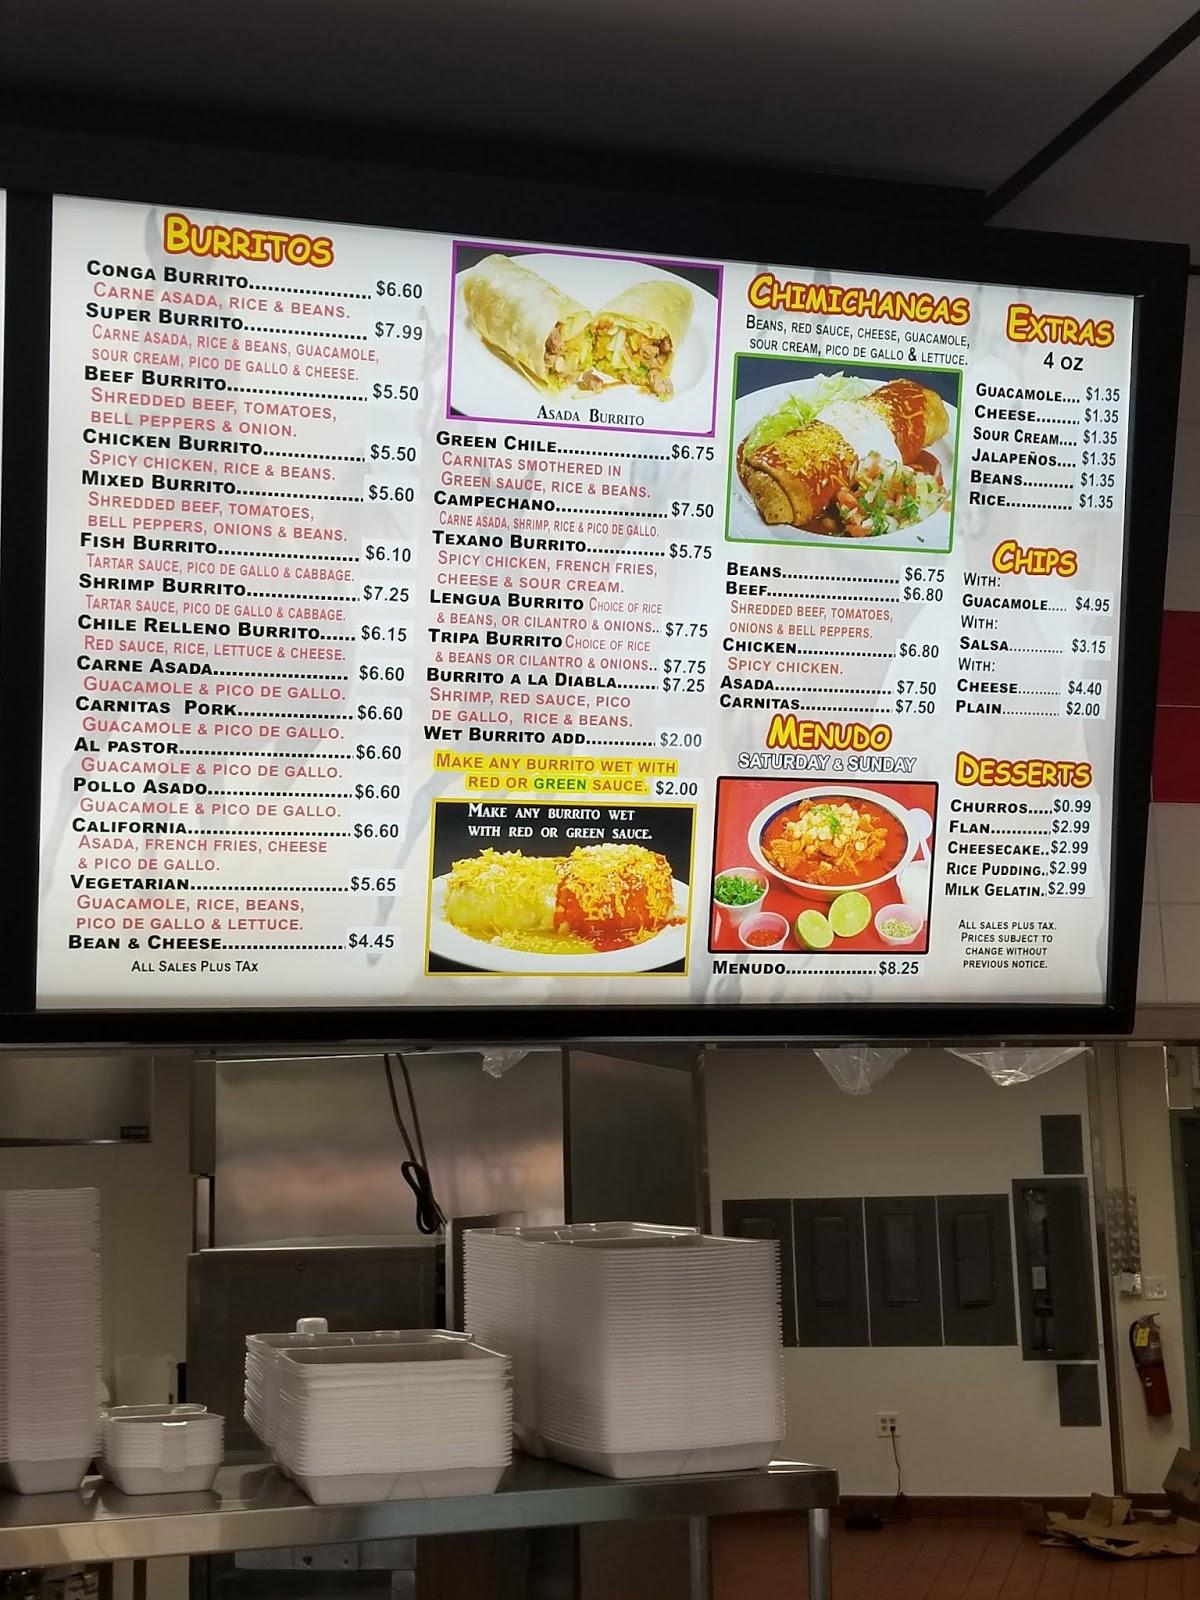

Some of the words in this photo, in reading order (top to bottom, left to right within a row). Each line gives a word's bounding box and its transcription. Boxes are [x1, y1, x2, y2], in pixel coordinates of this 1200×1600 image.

[164, 213, 334, 267] BURRITOS
[87, 260, 157, 282] CONGA
[376, 280, 422, 299] $6.60
[748, 272, 970, 325] CHIMICHANGAS
[86, 302, 151, 323] SUPER
[375, 321, 422, 341] $7.99
[1007, 304, 1115, 347] EXTRAS
[746, 314, 786, 334] BEANS,
[791, 322, 812, 336] RED
[814, 321, 853, 340] SAUCE,
[858, 328, 900, 344] CHEESE,
[905, 332, 969, 349] GUACAMOLE,
[750, 338, 778, 350] SOUR
[782, 339, 822, 354] CREAM,
[826, 344, 849, 358] PICO
[853, 347, 867, 357] DE
[871, 348, 903, 360] GALLO
[908, 347, 917, 361] &
[922, 352, 968, 365] LETTUCE.
[1043, 351, 1054, 369] 4
[1061, 356, 1084, 371] OZ
[85, 365, 134, 383] BEEF
[372, 383, 418, 401] $5.50
[1086, 386, 1120, 402] $1.35
[91, 387, 185, 408] SHREDDED
[193, 398, 237, 415] BEEF,
[244, 402, 336, 422] TOMATOES,
[536, 405, 580, 421] ASADA
[589, 408, 644, 426] BURRITO
[1085, 408, 1118, 424] $1.35
[973, 426, 1009, 442] SOUR
[1083, 429, 1117, 446] $1.35
[83, 428, 170, 449] CHICKEN
[368, 444, 416, 464] $5.50
[436, 431, 496, 449] GREEN
[671, 444, 714, 461] $6.75
[442, 451, 512, 469] CARNITAS
[518, 459, 603, 475] SMOTHERED
[608, 465, 621, 476] IN
[1082, 448, 1116, 468] $1.35
[82, 470, 144, 488] MIXED
[369, 484, 414, 502] $5.60
[1078, 470, 1115, 488] $1.35
[1079, 490, 1113, 509] $1.35
[672, 501, 714, 518] $7.50
[80, 532, 125, 549] FISH
[365, 545, 411, 562] $6.10
[432, 530, 503, 549] TEXANO
[669, 543, 712, 559] $5.75
[992, 540, 1078, 576] CHIPS
[905, 567, 944, 582] $6.75
[964, 572, 1000, 589] WITH:
[79, 573, 154, 591] SHRIMP
[363, 585, 409, 602] $7.25
[901, 586, 943, 603] $6.80
[430, 587, 501, 607] LENGUA
[508, 593, 584, 610] BURRITO
[589, 597, 624, 612] CHOICE
[628, 603, 639, 613] OF
[643, 604, 662, 614] RICE
[1075, 596, 1110, 612] $4.95
[731, 600, 793, 616] SHREDDED
[797, 606, 826, 620] BEEF,
[831, 607, 892, 623] TOMATOES,
[78, 614, 136, 631] CHILE
[144, 617, 231, 636] RELLENO
[361, 625, 407, 642] $6.15
[665, 622, 707, 638] $7.75
[730, 622, 773, 634] ONIONS
[777, 624, 784, 636] &
[788, 624, 816, 636] BELL
[820, 626, 872, 638] PEPPERS.
[961, 615, 998, 630] WITH:
[428, 628, 479, 644] TRIPA
[486, 628, 564, 648] BURRITO
[563, 634, 605, 650] CHOICE
[610, 640, 623, 651] OF
[628, 641, 650, 651] RICE
[1072, 638, 1106, 654] $3.15
[899, 642, 939, 658] $6.80
[77, 655, 143, 672] CARNE
[359, 665, 404, 681] $6.60
[664, 658, 706, 674] $7.75
[728, 656, 772, 675] SPICY
[776, 661, 843, 674] CHICKEN.
[958, 657, 995, 672] WITH:
[663, 677, 705, 693] $7.25
[897, 680, 936, 695] $7.50
[1068, 680, 1102, 696] $4.40
[76, 696, 170, 714] CARNITAS
[357, 704, 403, 722] $6.60
[895, 699, 935, 714] $7.50
[1066, 700, 1100, 716] $2.00
[424, 726, 463, 741] WET
[467, 727, 545, 743] BURRITO
[660, 732, 702, 747] $2.00
[767, 713, 892, 752] MENUDO
[356, 744, 401, 761] $6.60
[436, 754, 482, 768] MAKE
[488, 758, 520, 770] ANY
[526, 759, 594, 771] BURRITO
[600, 762, 632, 772] WET
[638, 762, 675, 774] WITH
[738, 753, 830, 771] SATURDAY
[834, 758, 844, 771] &
[848, 756, 916, 773] SUNDAY
[955, 751, 1092, 788] DESSERTS
[74, 777, 135, 793] POLLO
[355, 784, 400, 800] $6.60
[468, 776, 500, 788] RED
[506, 778, 527, 788] OR
[534, 778, 586, 790] GREEN
[592, 780, 648, 792] SAUCE.
[656, 780, 697, 796] $2.00
[468, 804, 507, 818] MAKE
[515, 808, 540, 818] ANY
[548, 809, 600, 820] BURRITO
[609, 810, 634, 820] WET
[1053, 799, 1091, 814] $0.99
[354, 823, 399, 839] $6.60
[468, 826, 500, 836] WITH
[508, 826, 533, 837] RED
[541, 828, 558, 838] OR
[566, 828, 604, 838] GREEN
[612, 829, 652, 840] SAUCE.
[1050, 819, 1090, 834] $2.99
[1051, 840, 1088, 855] $2.99
[946, 862, 979, 878] RICE
[1049, 860, 1087, 875] $2.99
[350, 876, 396, 892] $5.65
[945, 881, 981, 896] MILK
[1048, 881, 1085, 898] $2.99
[958, 919, 977, 933] ALL
[978, 921, 1010, 933] SALES
[1011, 922, 1035, 933] PLUS
[1036, 922, 1056, 933] TAX.
[349, 933, 394, 949] $4.45
[961, 930, 995, 945] PRICES
[998, 934, 1038, 944] SUBJECT
[1041, 932, 1053, 943] TO
[965, 944, 1003, 958] CHANGE
[1006, 945, 1048, 958] WITHOUT
[131, 960, 156, 972] ALL
[157, 959, 197, 972] SALES
[201, 960, 231, 972] PLUS
[879, 961, 919, 976] $8.25
[963, 957, 1009, 968] PREVIOUS
[1012, 957, 1047, 968] NOTICE.
